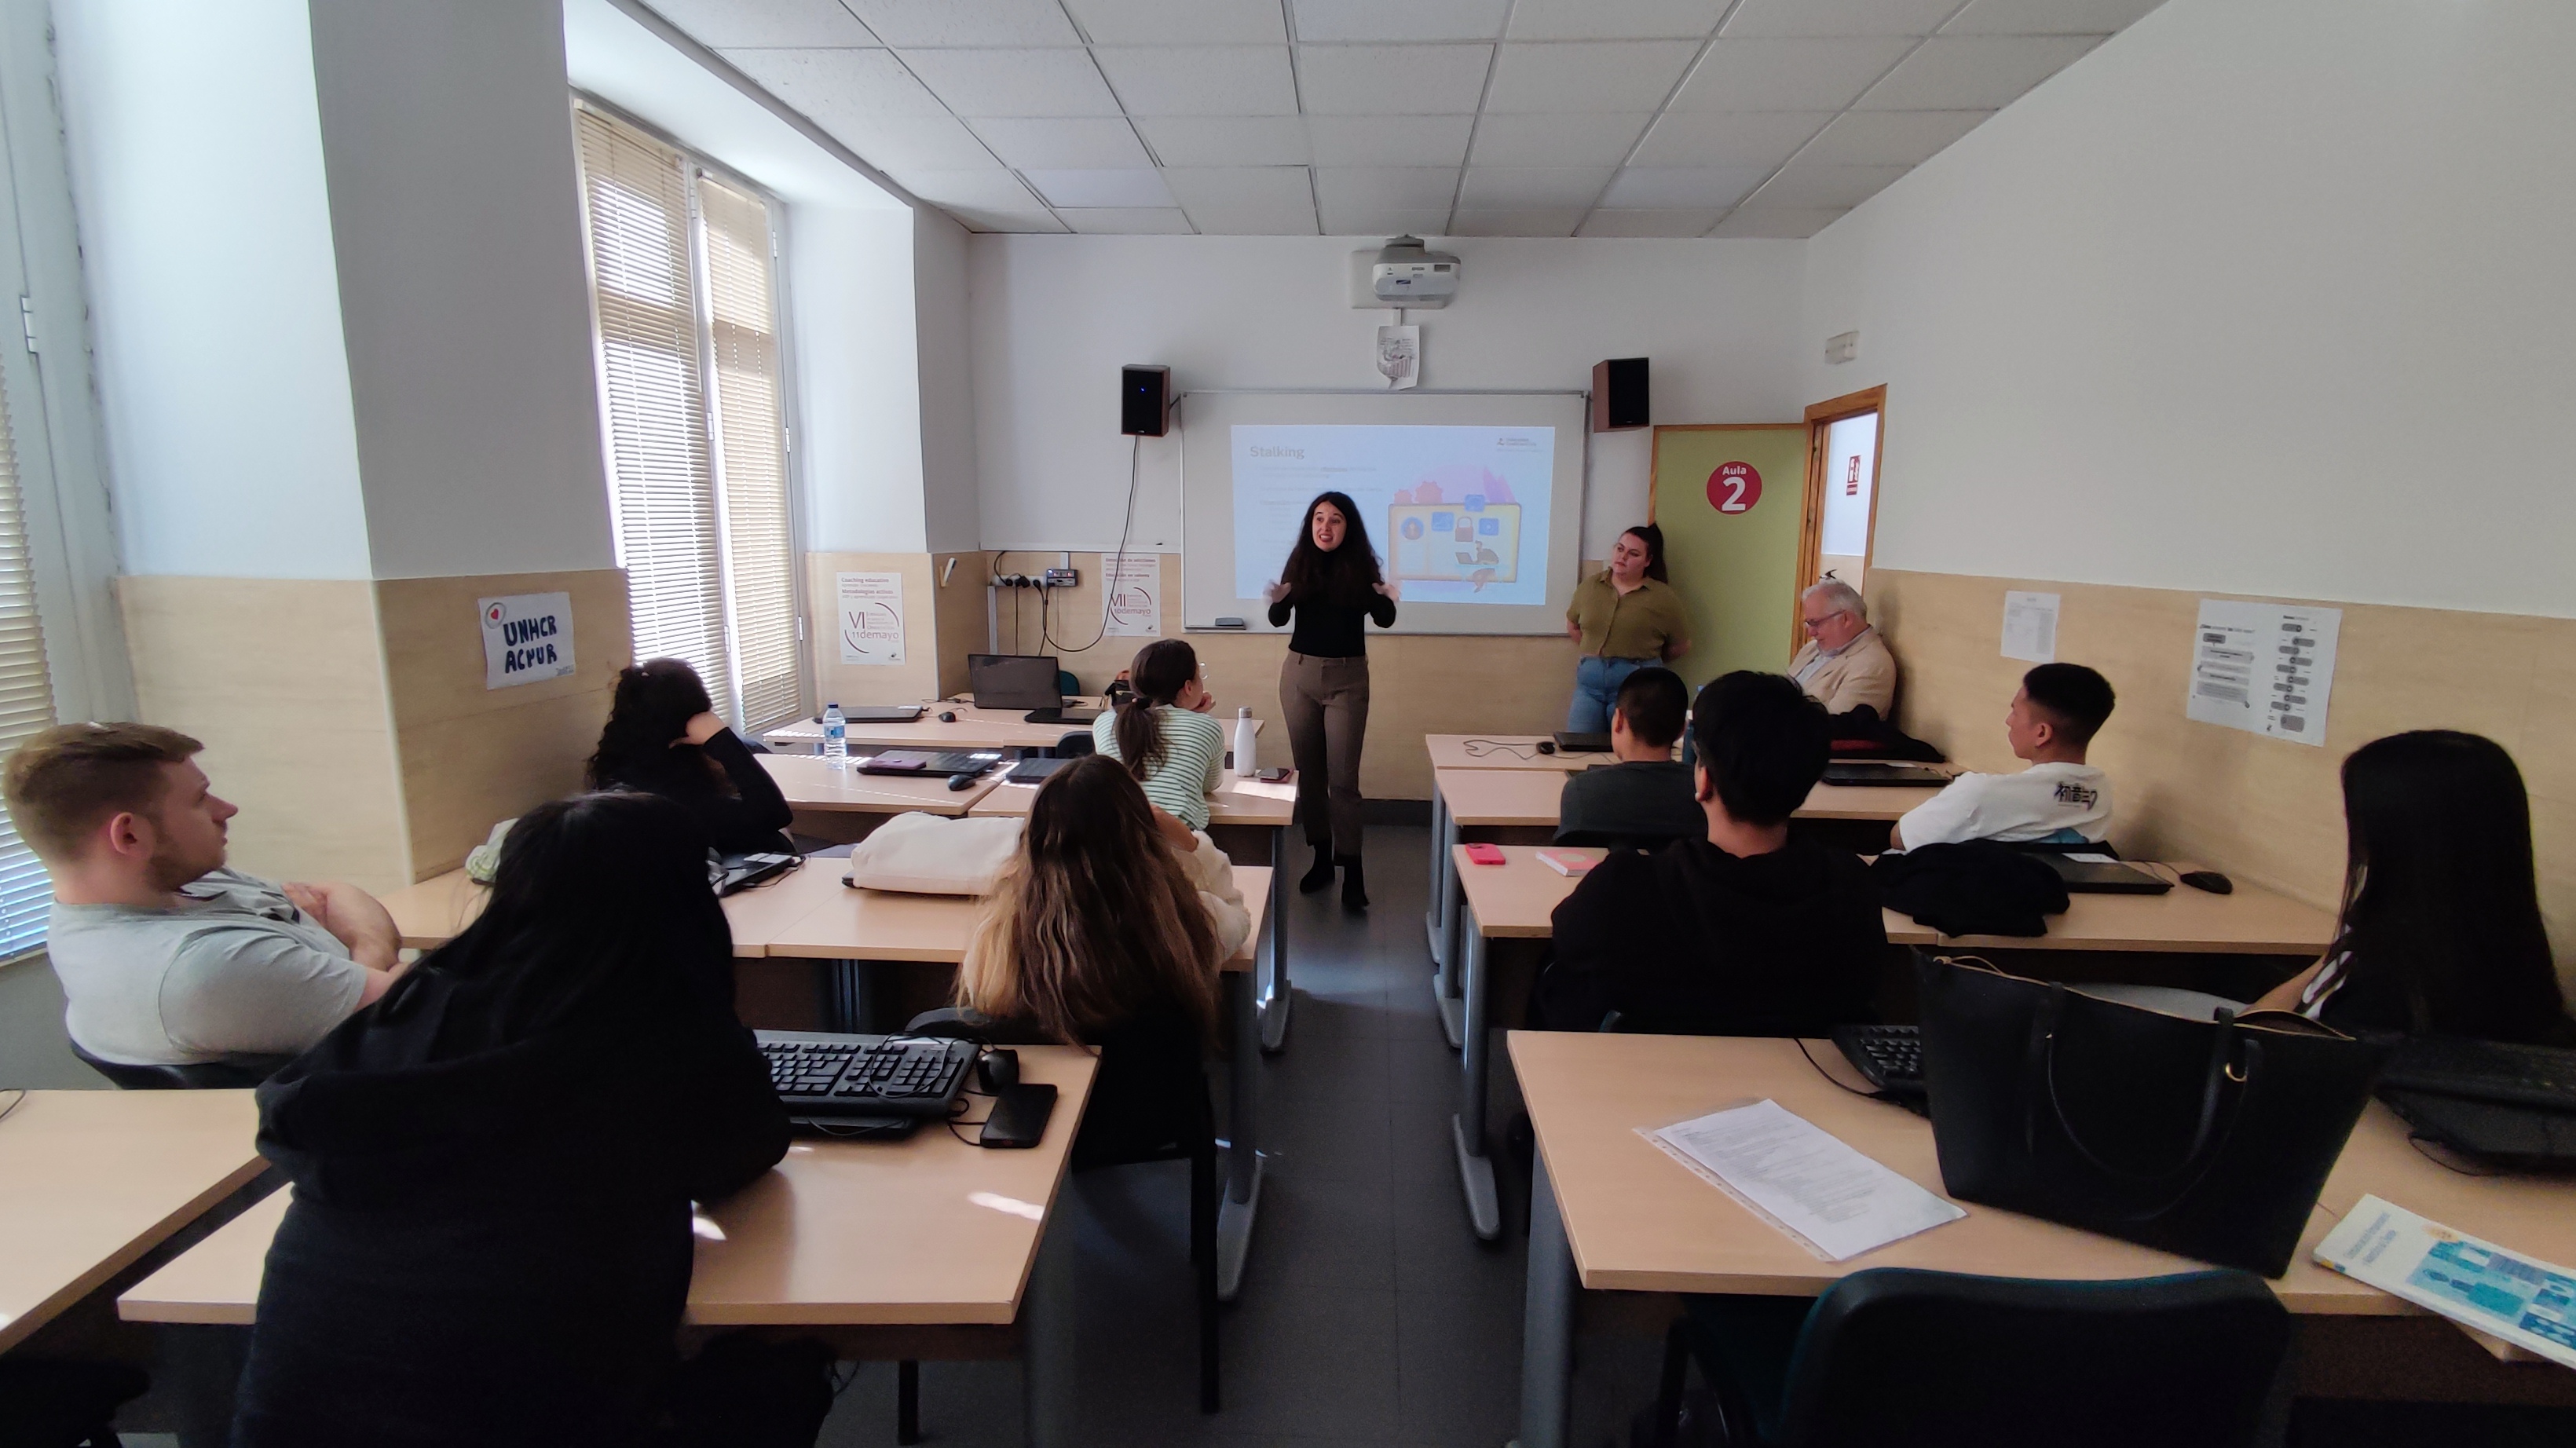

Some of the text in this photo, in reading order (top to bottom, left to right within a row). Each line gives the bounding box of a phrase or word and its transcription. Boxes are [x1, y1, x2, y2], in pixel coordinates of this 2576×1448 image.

[1250, 446, 1304, 459] Stalking
[1722, 466, 1747, 476] Aula
[1722, 477, 1746, 511] 2
[848, 611, 865, 629] VI
[503, 615, 557, 646] UNHCR
